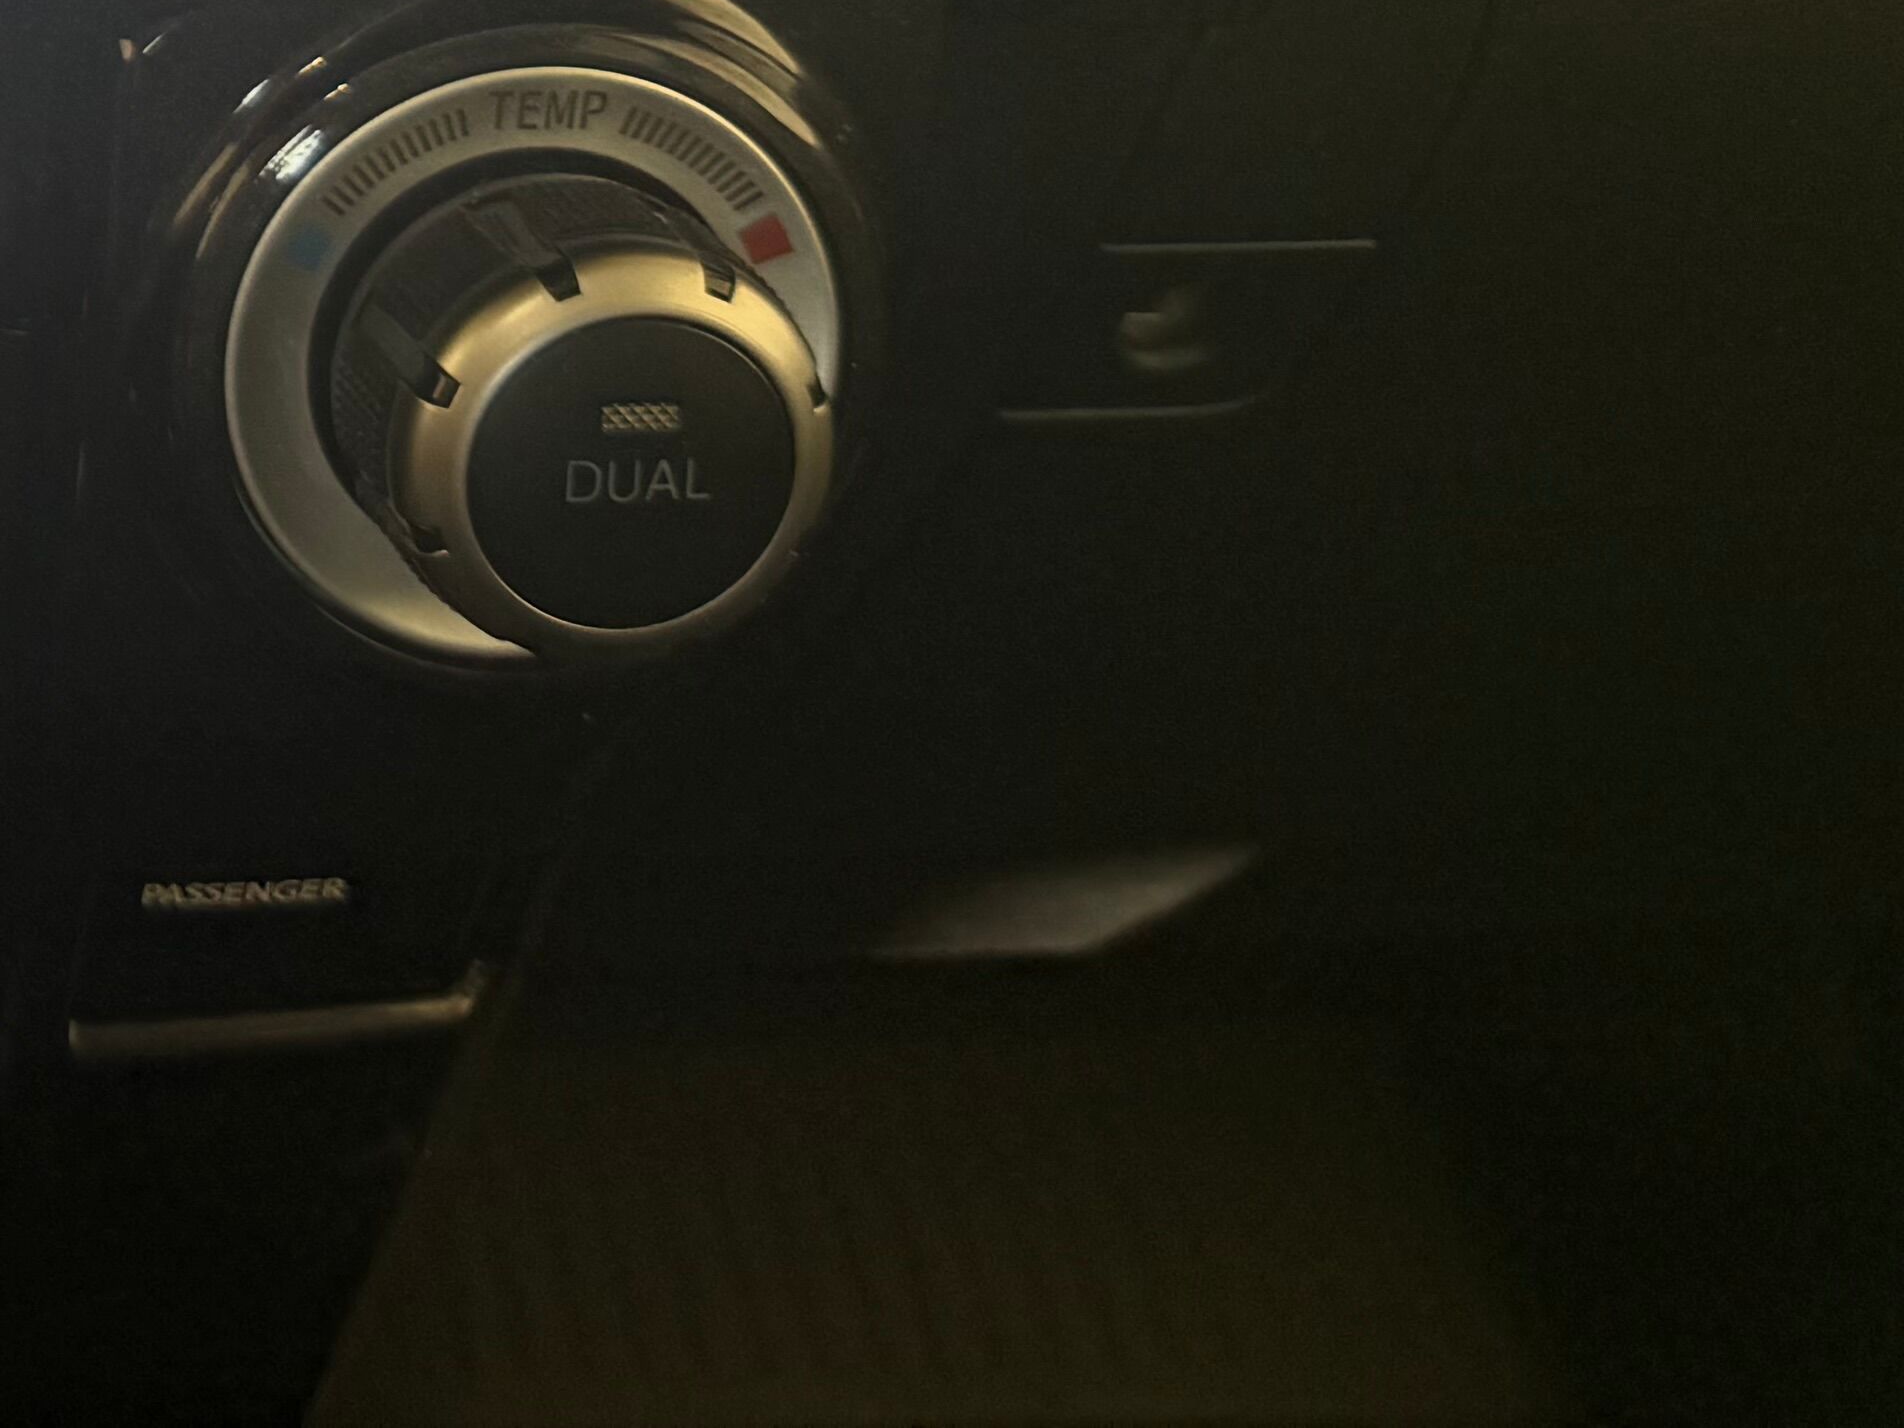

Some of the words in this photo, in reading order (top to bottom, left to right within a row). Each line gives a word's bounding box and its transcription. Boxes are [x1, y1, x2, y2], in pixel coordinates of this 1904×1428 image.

[489, 90, 610, 134] TEMP
[564, 460, 710, 502] DUAL
[140, 875, 350, 911] PASSENGER
